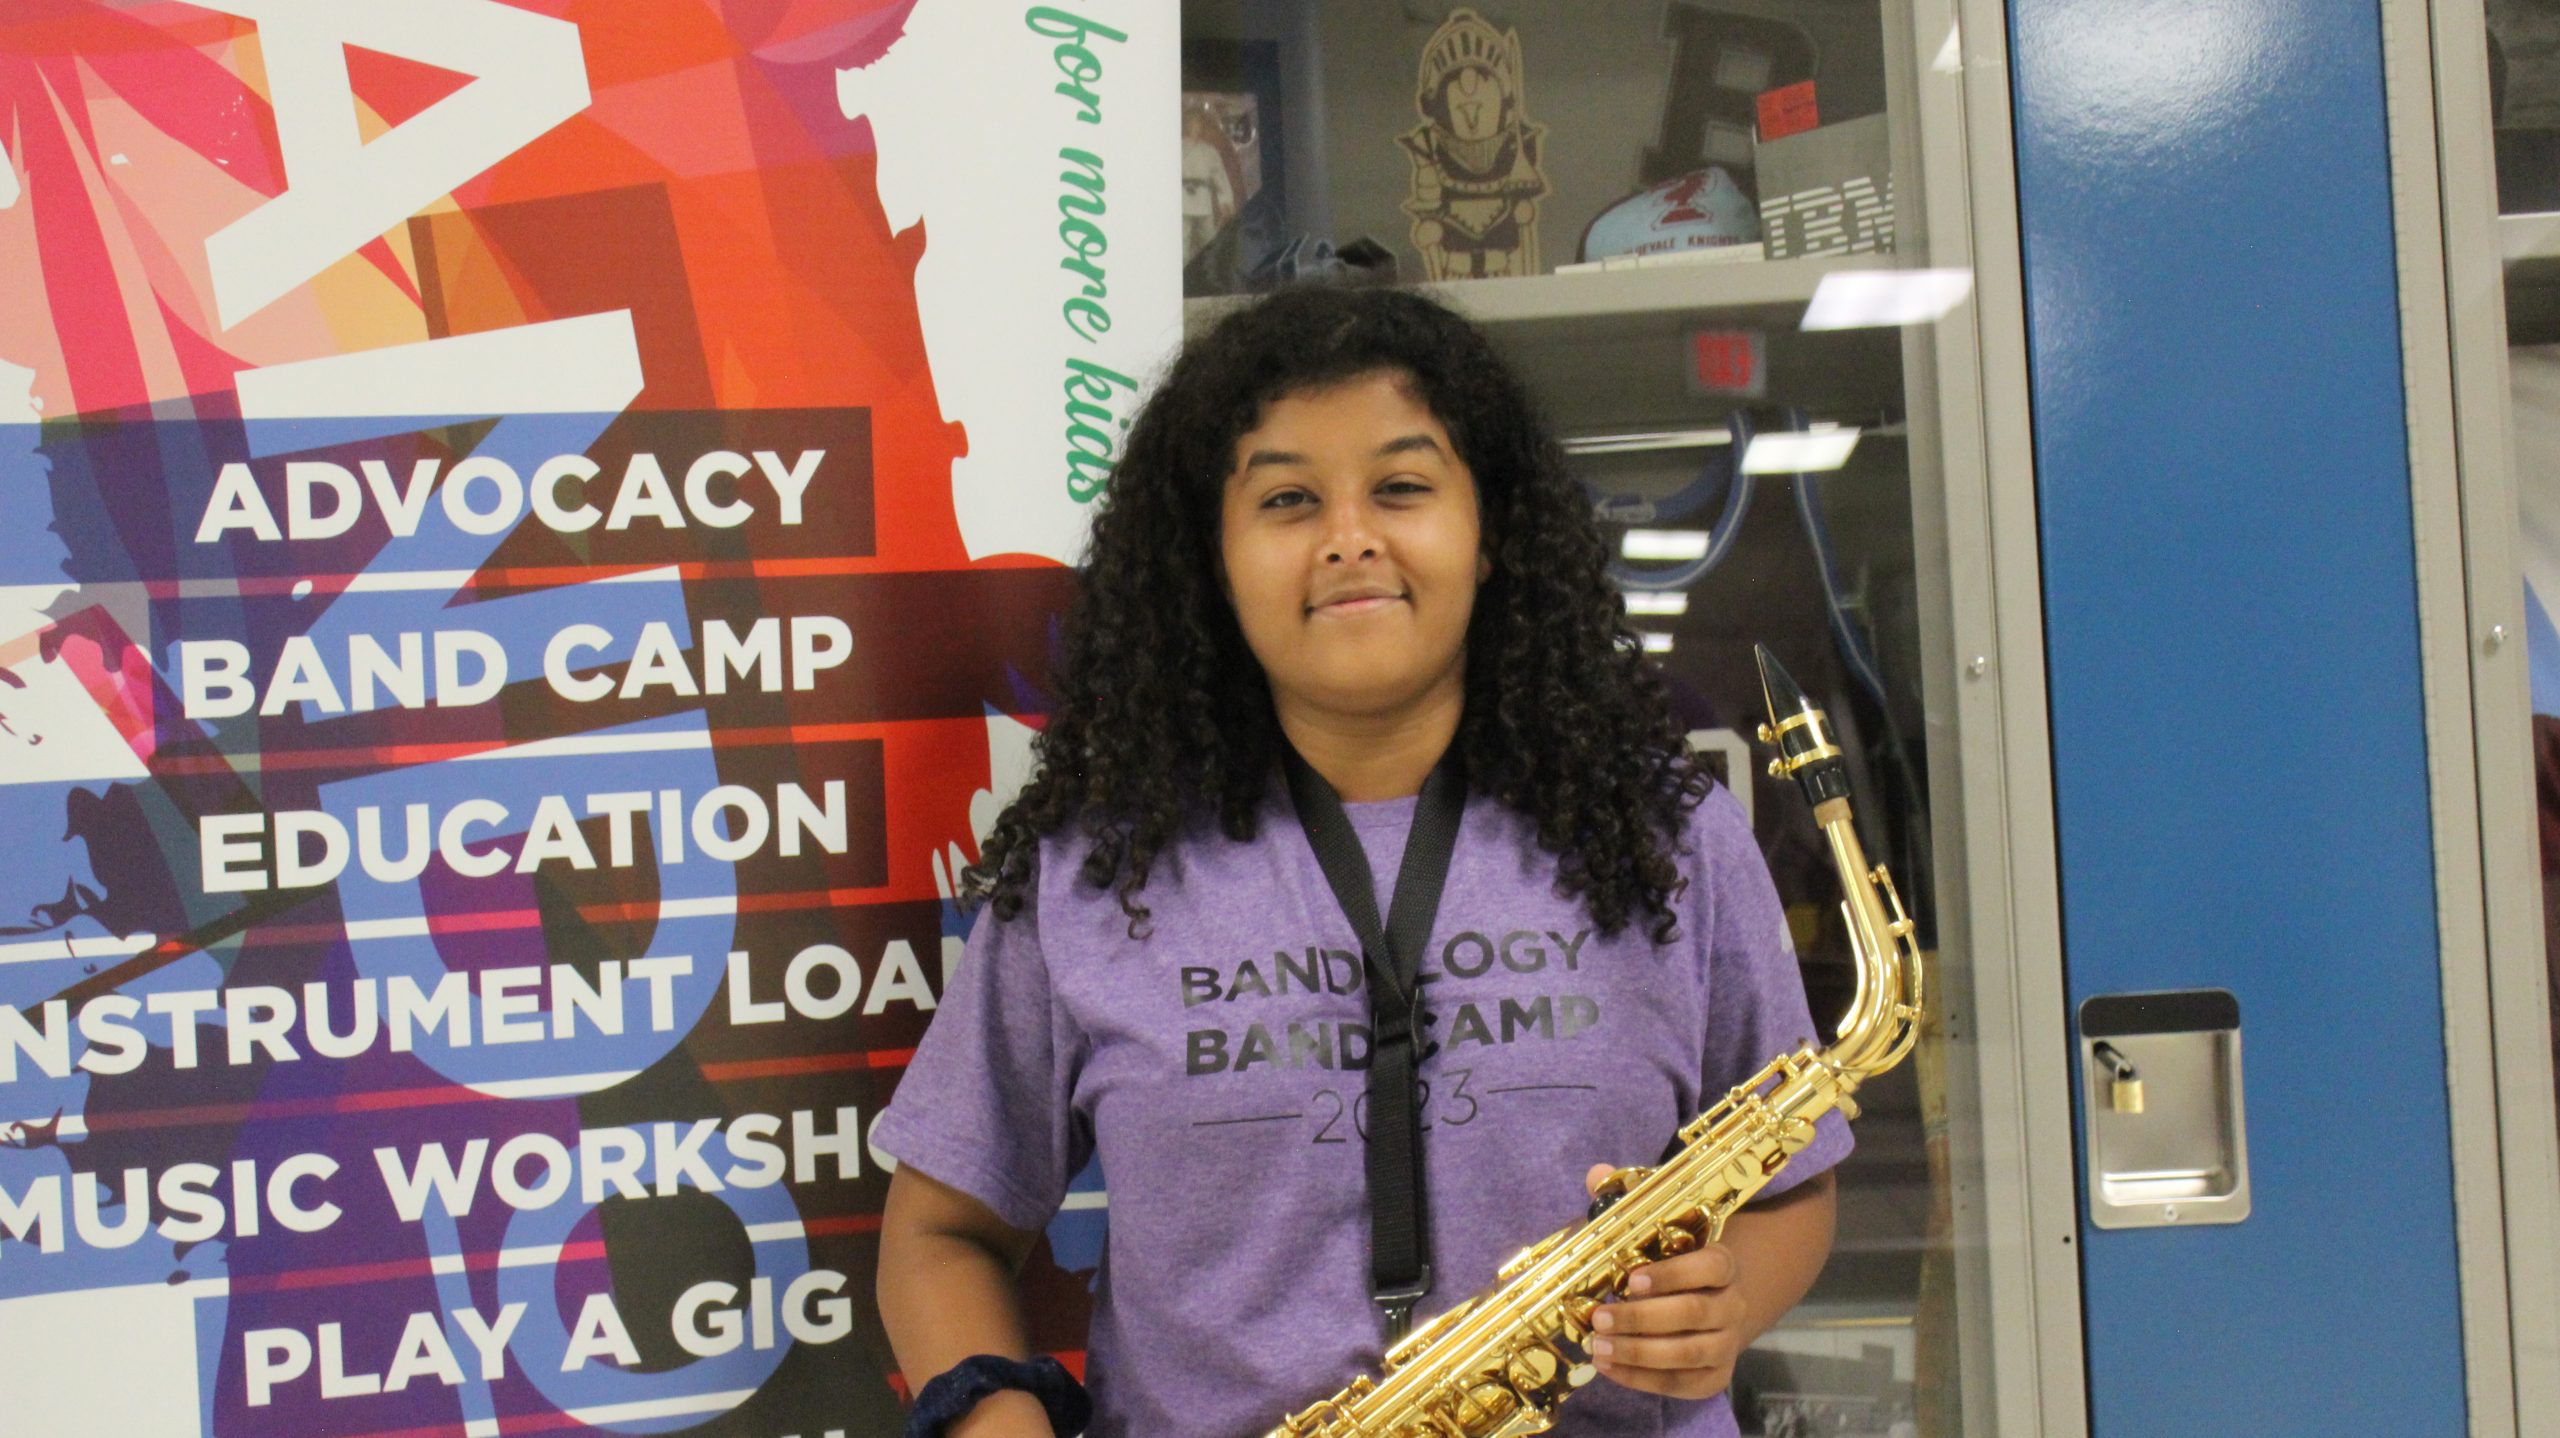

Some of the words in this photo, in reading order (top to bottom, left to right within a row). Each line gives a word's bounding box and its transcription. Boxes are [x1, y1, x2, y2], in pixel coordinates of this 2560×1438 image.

[1025, 5, 1129, 125] for
[1058, 147, 1112, 344] more
[194, 449, 826, 544] ADVOCACY
[180, 629, 508, 719] BAND
[543, 616, 853, 702] CAMP
[200, 780, 847, 893] EDUCATION
[1187, 1019, 1375, 1075] BAND
[0, 1153, 342, 1258] MUSIC
[244, 1302, 528, 1407] PLAY
[560, 1293, 642, 1372] A
[672, 1270, 852, 1357] GIG
